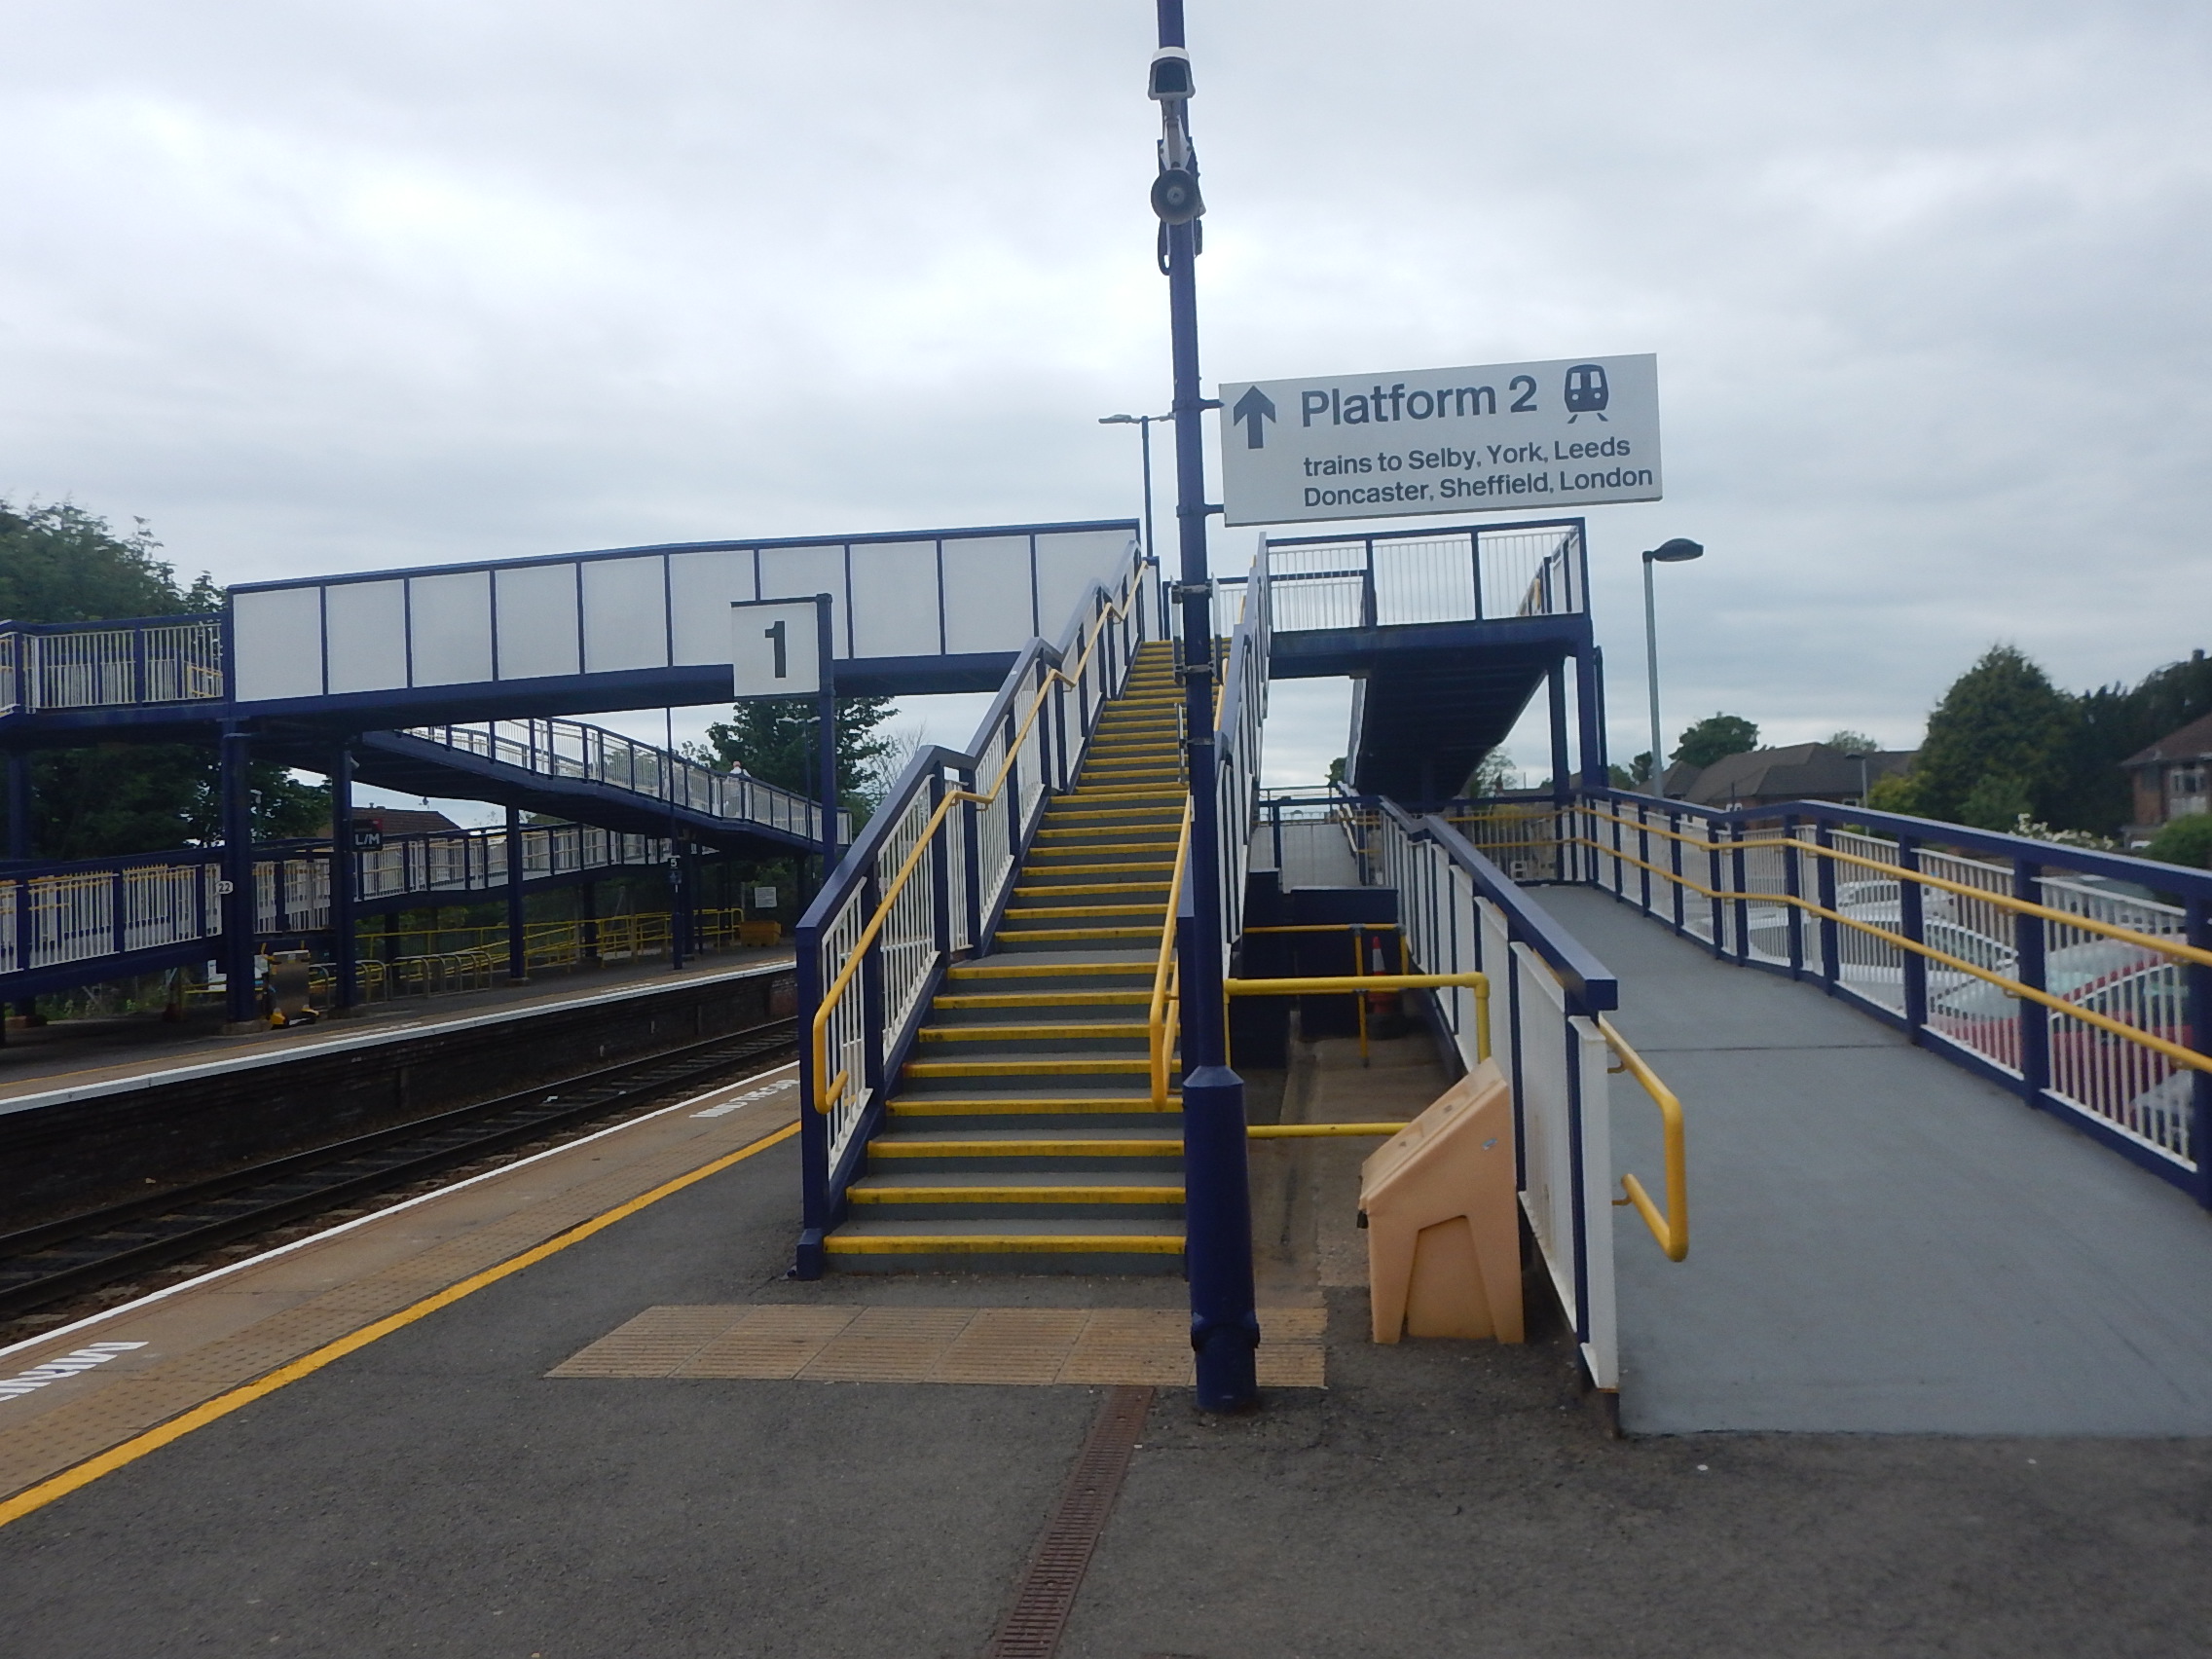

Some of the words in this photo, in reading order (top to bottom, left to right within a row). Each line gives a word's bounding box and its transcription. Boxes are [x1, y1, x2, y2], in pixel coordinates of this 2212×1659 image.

[1301, 383, 1497, 428] Platform
[1508, 374, 1539, 414] 2
[1303, 450, 1374, 477] trains
[1377, 451, 1404, 472] to
[1408, 446, 1483, 471] Selby,
[1486, 441, 1549, 465] York,
[1554, 435, 1632, 461] Leeds
[1303, 477, 1435, 507] Doncaster,
[1440, 470, 1555, 498] Sheffield,
[1560, 466, 1654, 492] London
[764, 620, 787, 679] 1
[354, 832, 381, 846] L/M
[218, 882, 231, 893] 22
